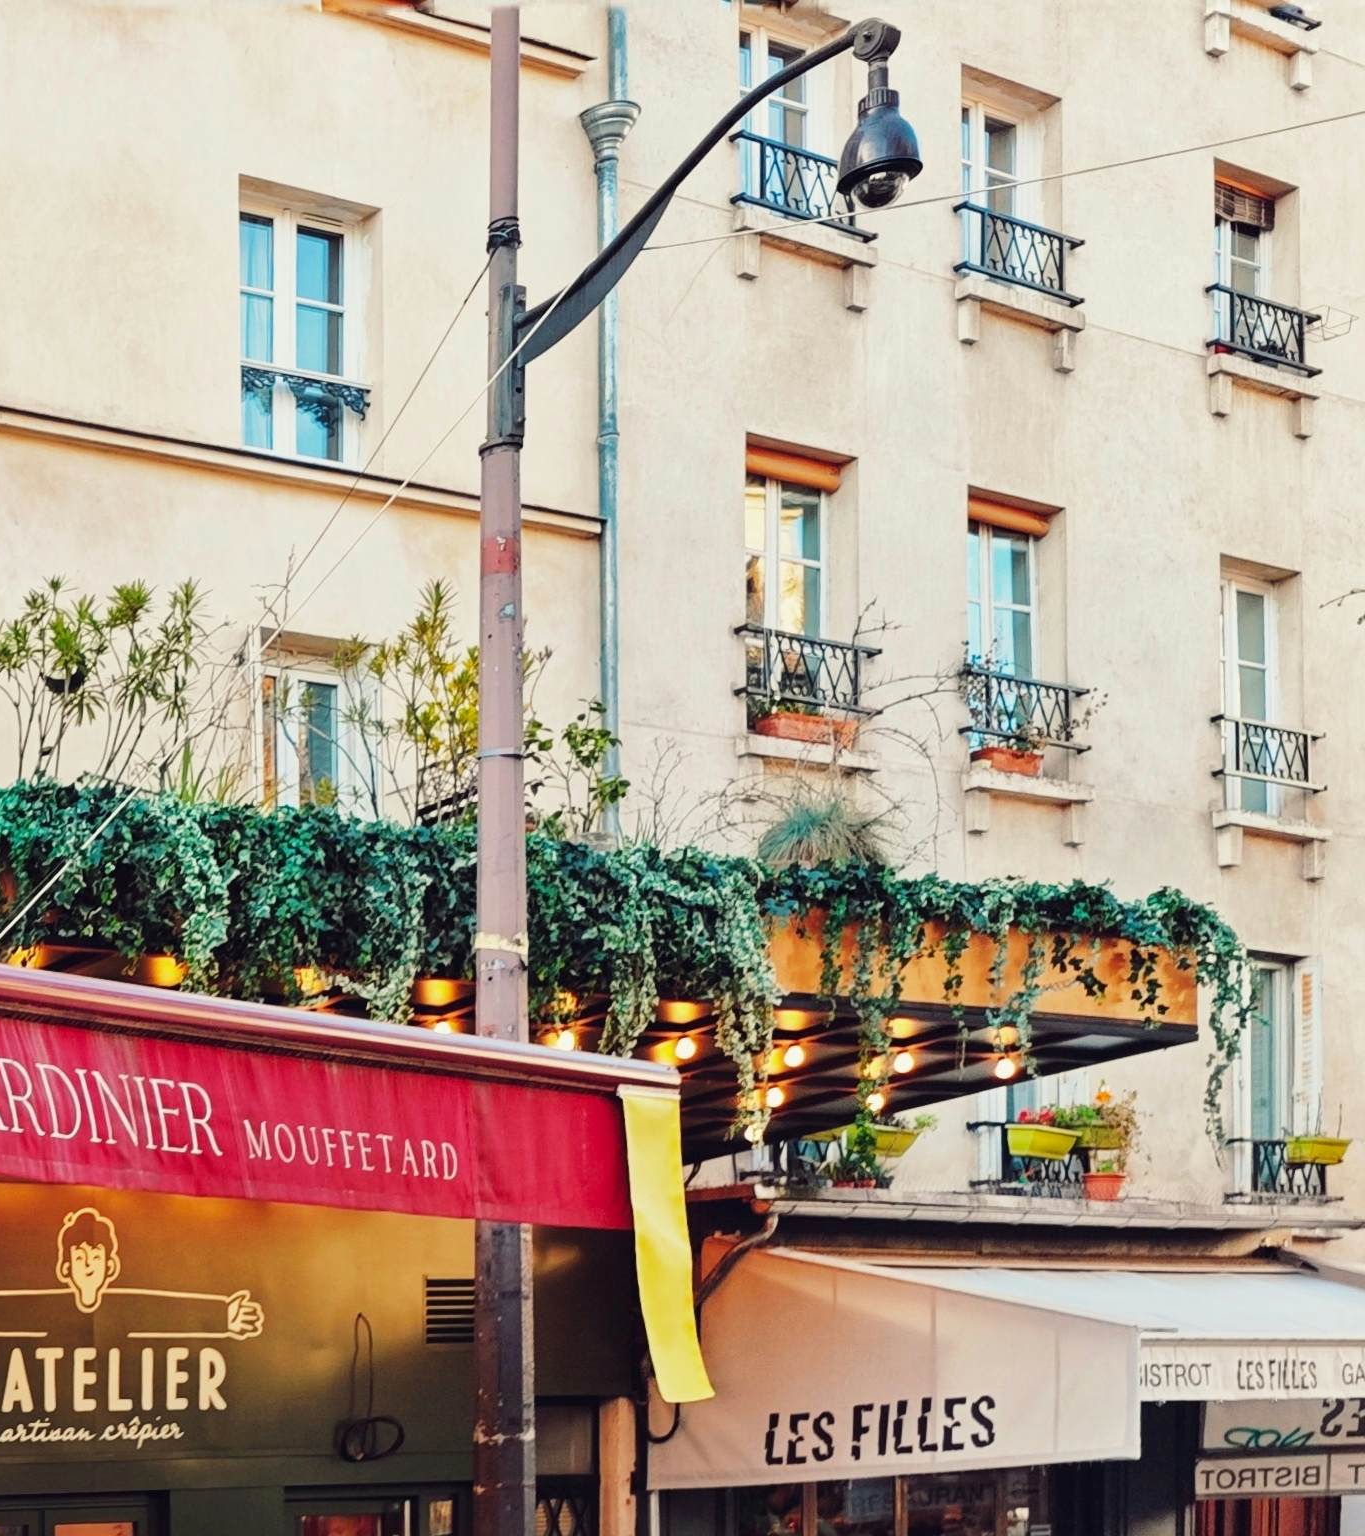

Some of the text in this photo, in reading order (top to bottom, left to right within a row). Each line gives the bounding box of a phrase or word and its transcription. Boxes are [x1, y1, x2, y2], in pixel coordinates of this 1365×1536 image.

[243, 1117, 460, 1182] MOUFFETARD
[1236, 1359, 1265, 1391] LES
[1268, 1358, 1318, 1391] FILLES
[763, 1395, 998, 1467] LES FILLES
